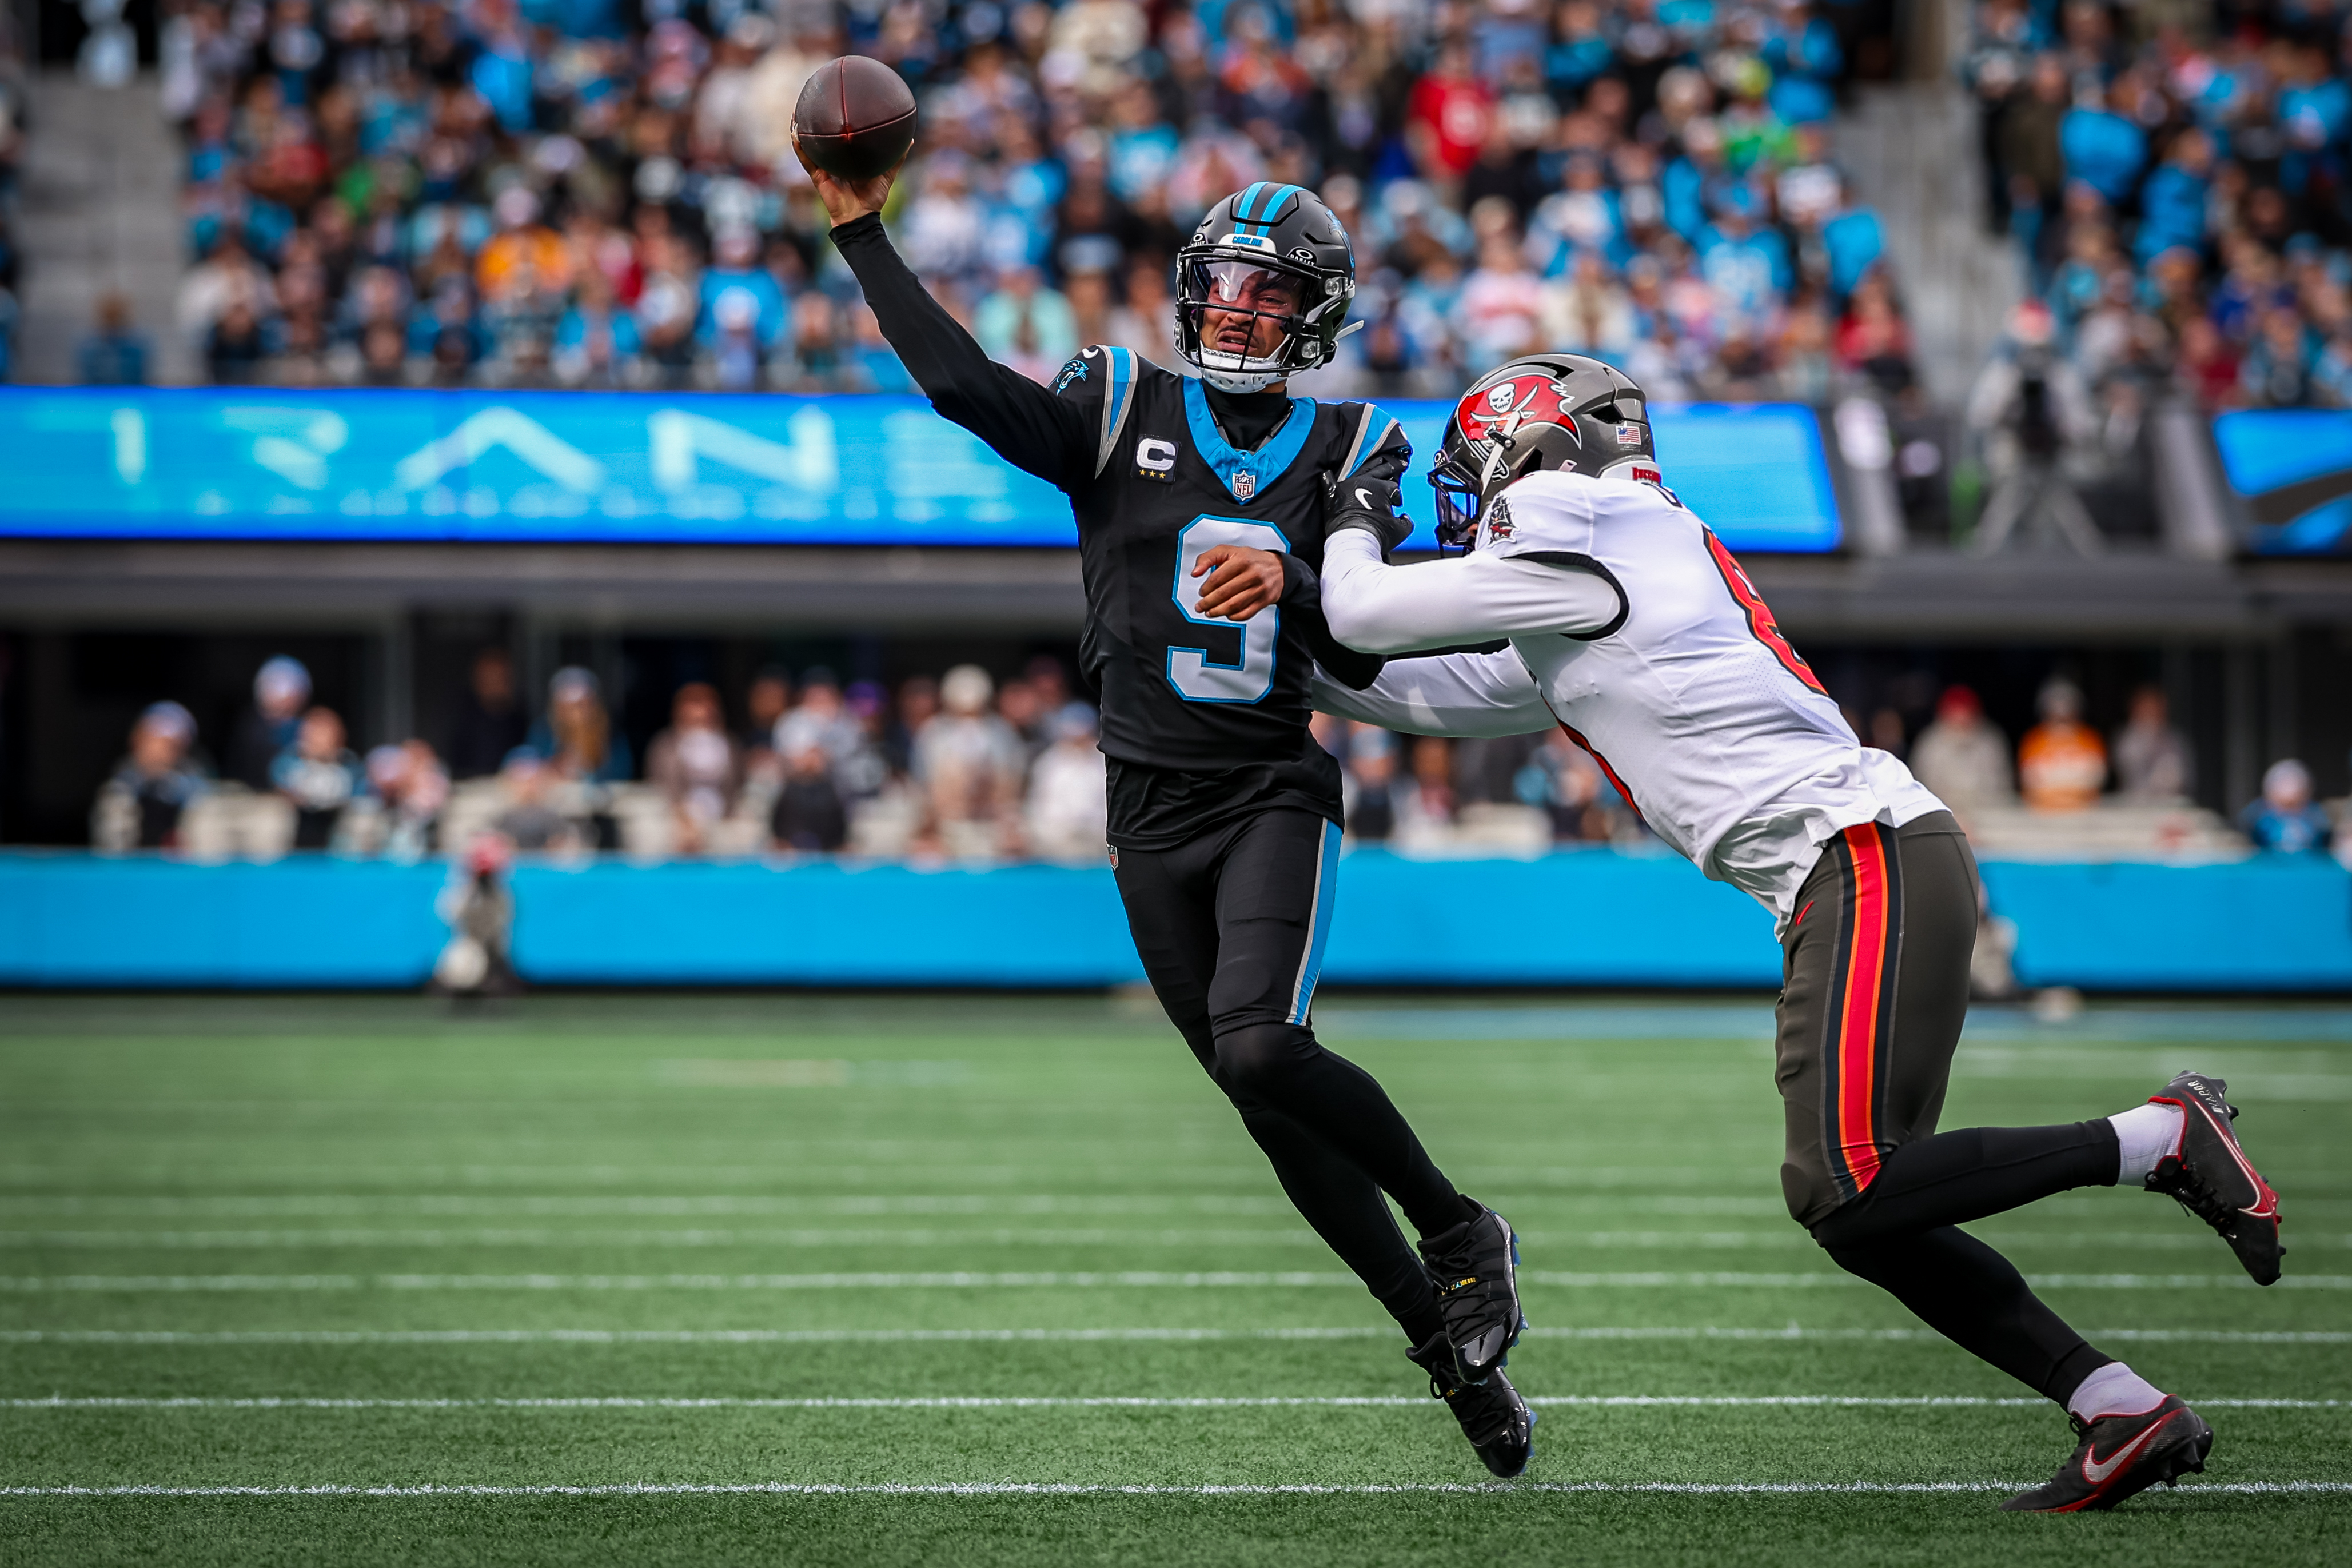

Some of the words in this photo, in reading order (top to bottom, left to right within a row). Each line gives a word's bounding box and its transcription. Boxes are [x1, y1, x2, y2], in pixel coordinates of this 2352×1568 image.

[1233, 236, 1263, 246] CAROLINA
[1290, 254, 1314, 266] OAKLEY
[1137, 438, 1176, 471] C
[1236, 484, 1252, 496] NFL
[1167, 513, 1291, 704] 9
